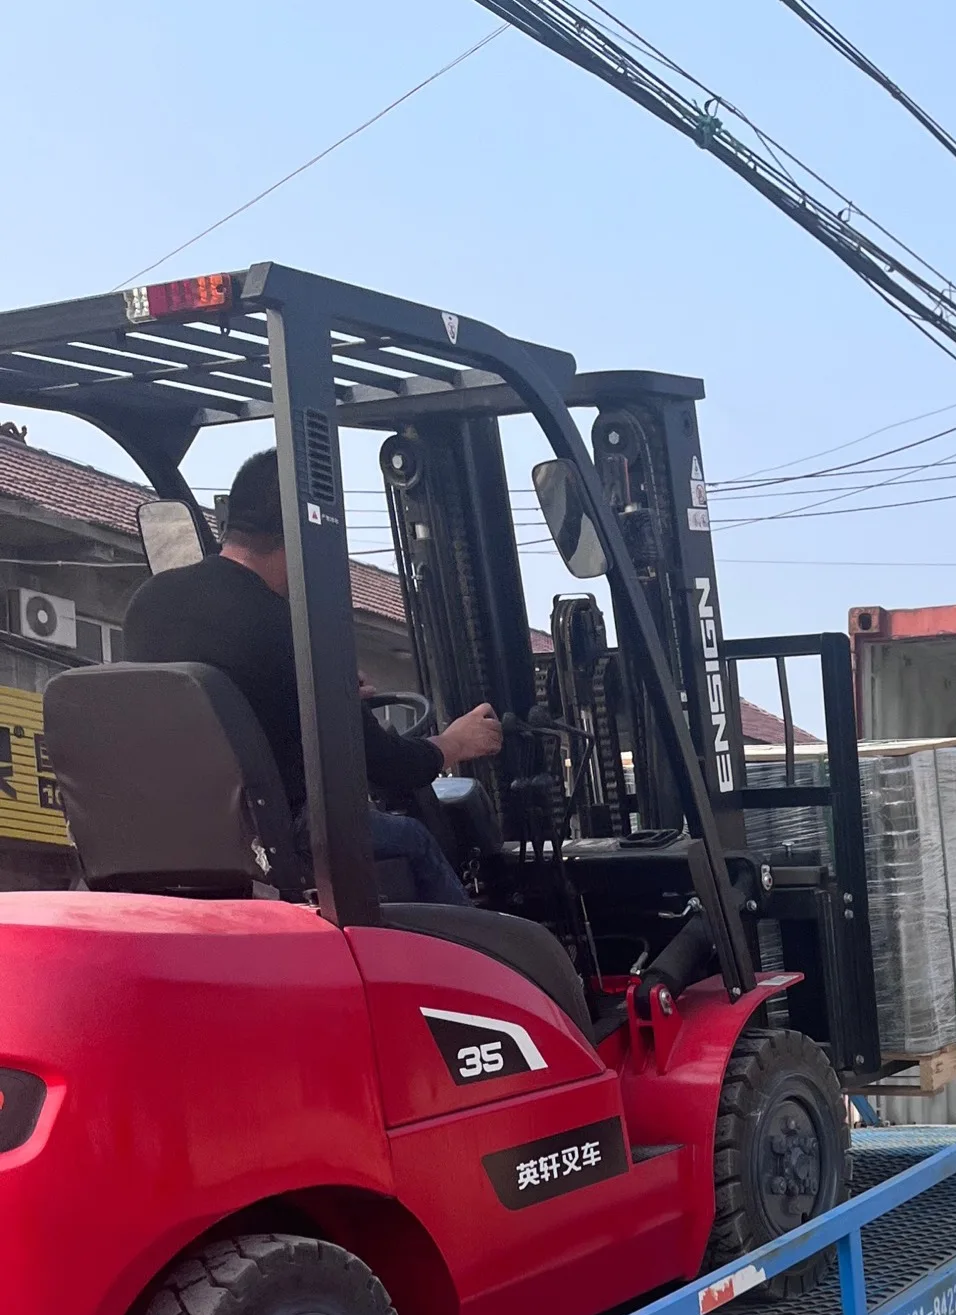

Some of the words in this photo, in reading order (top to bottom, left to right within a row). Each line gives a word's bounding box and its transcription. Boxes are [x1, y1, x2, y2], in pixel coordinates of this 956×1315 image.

[695, 577, 734, 793] ENSIGN
[457, 1041, 504, 1078] 35
[516, 1141, 602, 1191] 英轩叉车
